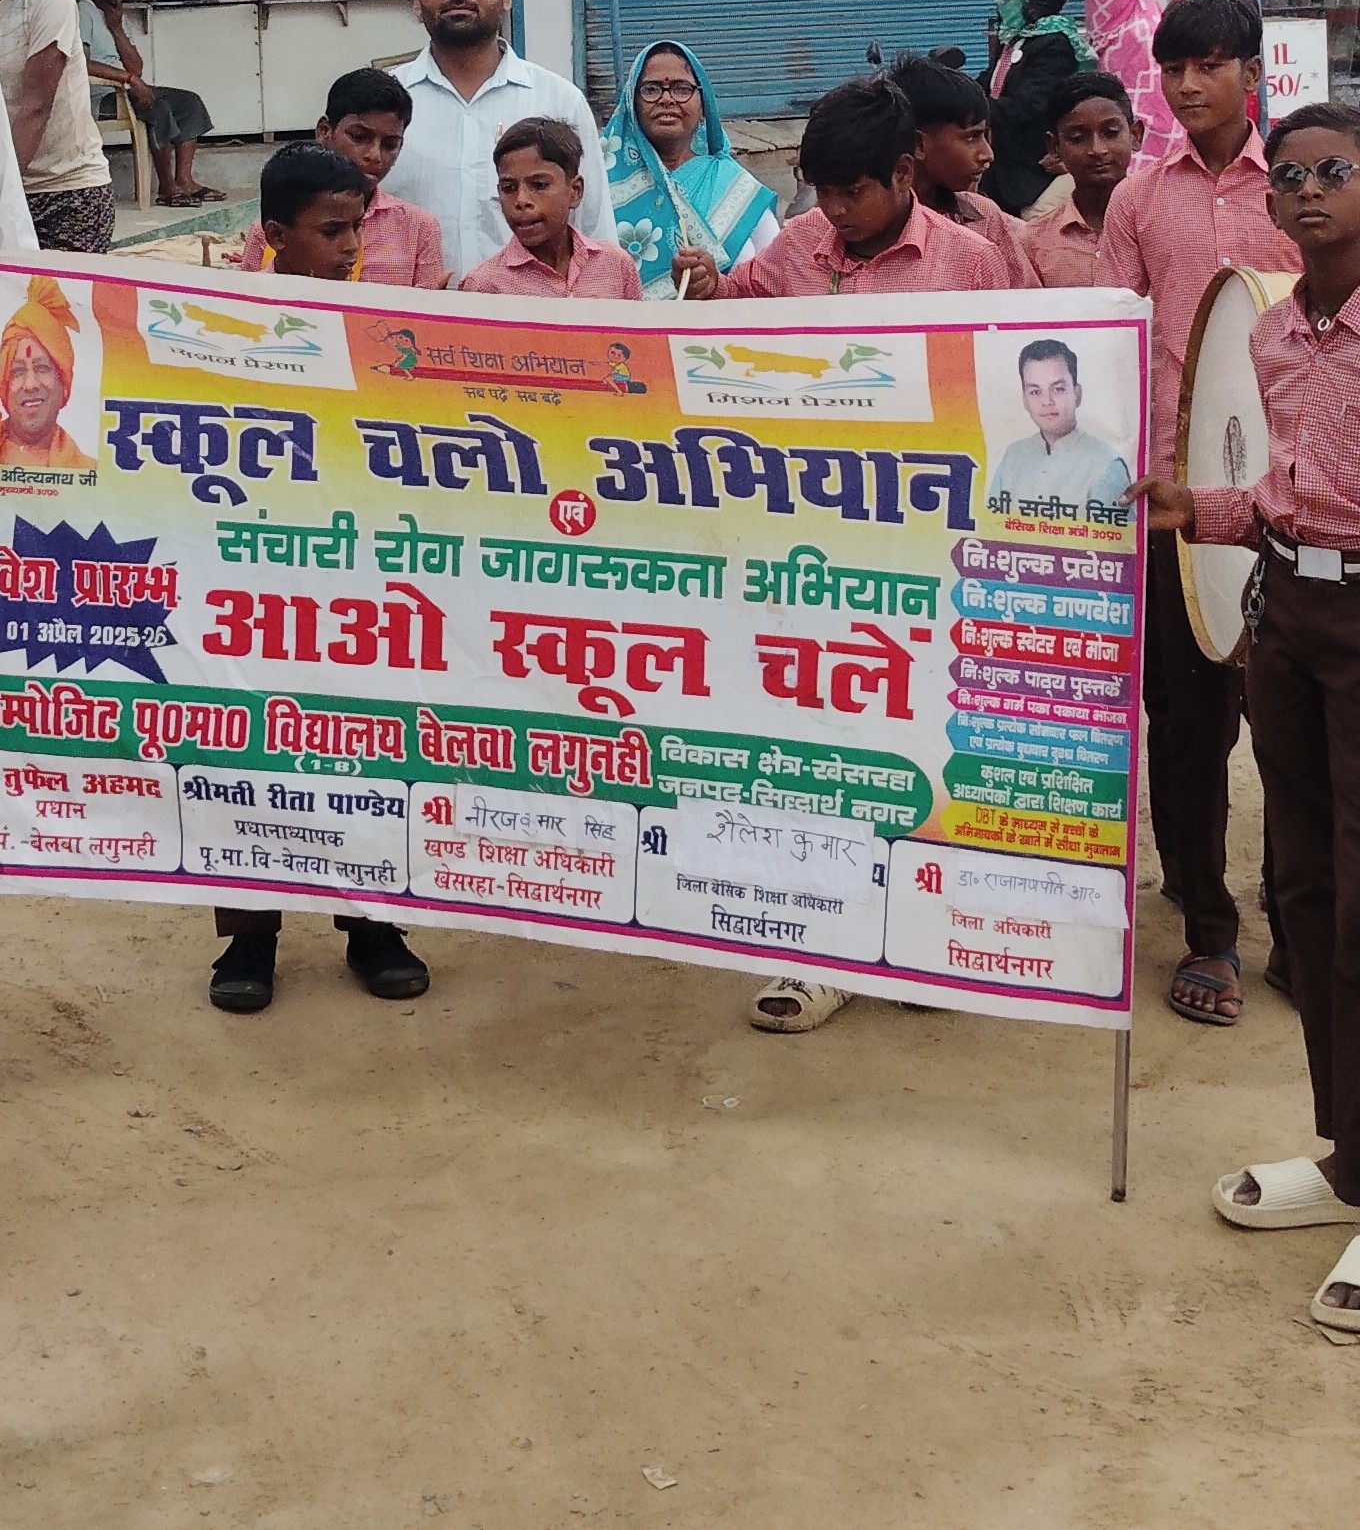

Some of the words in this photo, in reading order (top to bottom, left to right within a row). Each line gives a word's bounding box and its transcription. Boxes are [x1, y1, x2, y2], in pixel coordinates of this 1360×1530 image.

[426, 345, 455, 366] सर्व
[460, 345, 505, 370] शिक्षा
[511, 351, 586, 376] अभियान
[706, 392, 793, 407] मिशन
[1, 466, 75, 487] अदित्यनाथ
[79, 469, 98, 488] जी
[105, 399, 319, 507] स्कूल
[355, 413, 548, 496] चलो
[590, 427, 979, 531] अभियान
[557, 493, 589, 534] एवं
[987, 490, 1012, 515] श्री
[1018, 495, 1079, 522] संदीप
[1085, 500, 1130, 527] सिंह
[216, 509, 359, 571] संचारी
[374, 513, 464, 578] रोग
[480, 537, 728, 600] जागरूकता
[743, 544, 941, 620] अभियान
[1062, 551, 1124, 583] प्रवेश
[72, 559, 180, 608] प्रारम्भ
[1053, 591, 1131, 625] गणवेश
[37, 618, 83, 645] अप्रैल
[202, 582, 448, 671] आओ
[490, 610, 712, 718] स्कूल
[755, 621, 932, 720] चलें
[1086, 633, 1120, 663] मोजा
[265, 696, 404, 760] विद्यालय
[419, 709, 515, 769] बेलवा
[529, 729, 652, 793] लगुनही
[660, 735, 750, 770] विकास
[83, 772, 163, 799] अहमद
[980, 764, 1016, 788] कुशल
[1018, 767, 1040, 786] एवं
[1041, 770, 1094, 795] प्रशिक्षित
[36, 799, 87, 820] प्रधान
[183, 775, 256, 807] श्रीमती
[267, 783, 315, 812] रीता
[327, 789, 405, 819] पाण्डेय
[421, 796, 454, 826] श्री
[850, 798, 918, 827] नगर
[953, 783, 1012, 806] अध्यापकों
[1048, 792, 1088, 817] शिक्षण
[234, 820, 345, 847] प्रधानाध्यापक
[584, 814, 617, 841] सिंह
[641, 825, 668, 856] श्री
[706, 809, 783, 849] शैलेश
[790, 828, 866, 867] कुमार
[89, 831, 158, 863] लगुनही
[424, 838, 468, 861] खण्ड
[478, 836, 528, 866] शिक्षा
[535, 845, 616, 878] अधिकारी
[334, 859, 397, 886] लगुनही
[676, 872, 708, 895] जिला
[754, 885, 789, 905] शिक्षा
[915, 861, 943, 895] श्री
[951, 909, 985, 931] जिला
[993, 916, 1053, 939] अधिकारी
